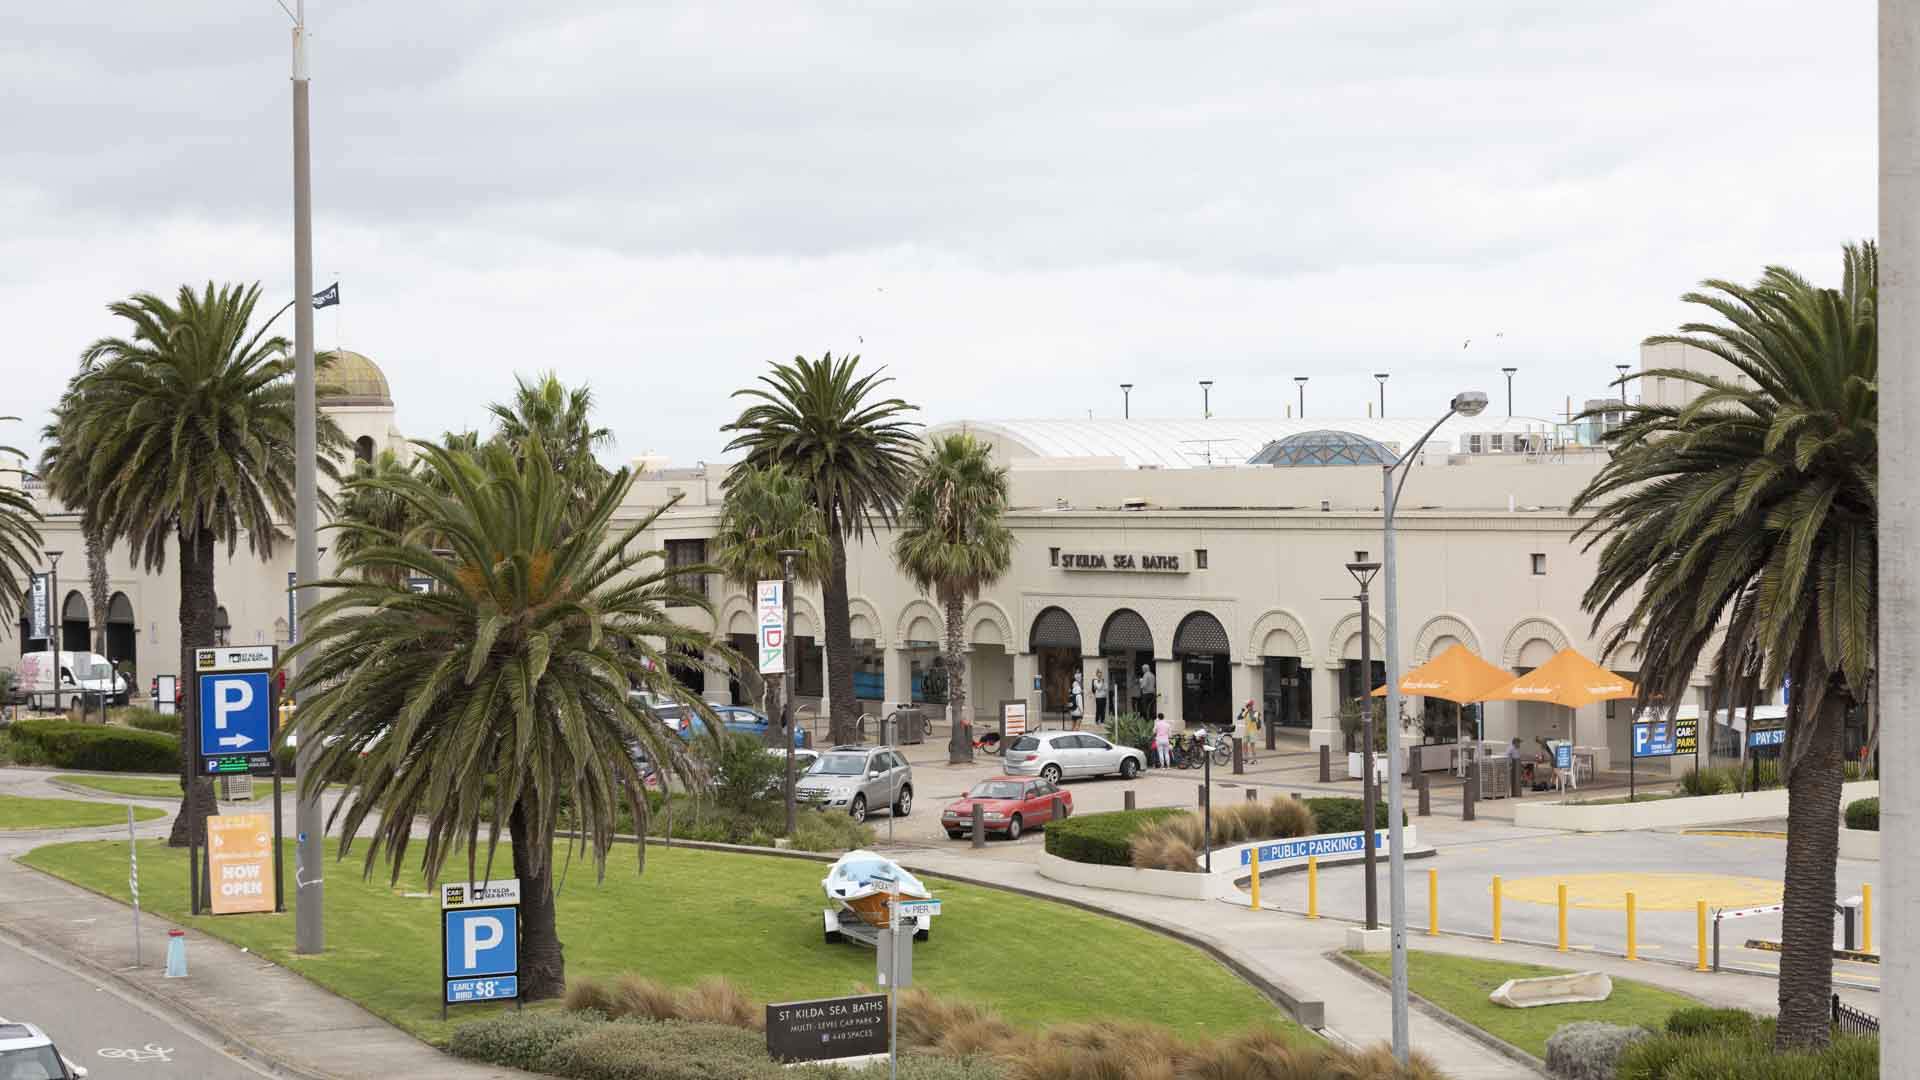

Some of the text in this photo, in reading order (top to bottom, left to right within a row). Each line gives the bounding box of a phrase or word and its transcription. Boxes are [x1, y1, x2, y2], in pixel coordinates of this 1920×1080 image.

[1062, 554, 1179, 569] ST KILDA SEA BATHS
[214, 679, 253, 729] P
[1636, 727, 1648, 753] P
[1676, 738, 1696, 747] PARK
[1755, 731, 1771, 744] PAY
[208, 760, 217, 771] P
[1271, 843, 1307, 859] PUBLIC
[1309, 837, 1358, 854] PARKING
[222, 864, 260, 880] NOW
[222, 881, 262, 896] OPEN
[912, 905, 929, 914] PIER
[463, 916, 504, 969] P
[453, 982, 473, 991] EARLY
[779, 1001, 883, 1021] ST KILDA SEA BATHS
[839, 1019, 854, 1027] CAR
[855, 1017, 873, 1025] PARK
[847, 1029, 873, 1039] SPACES
